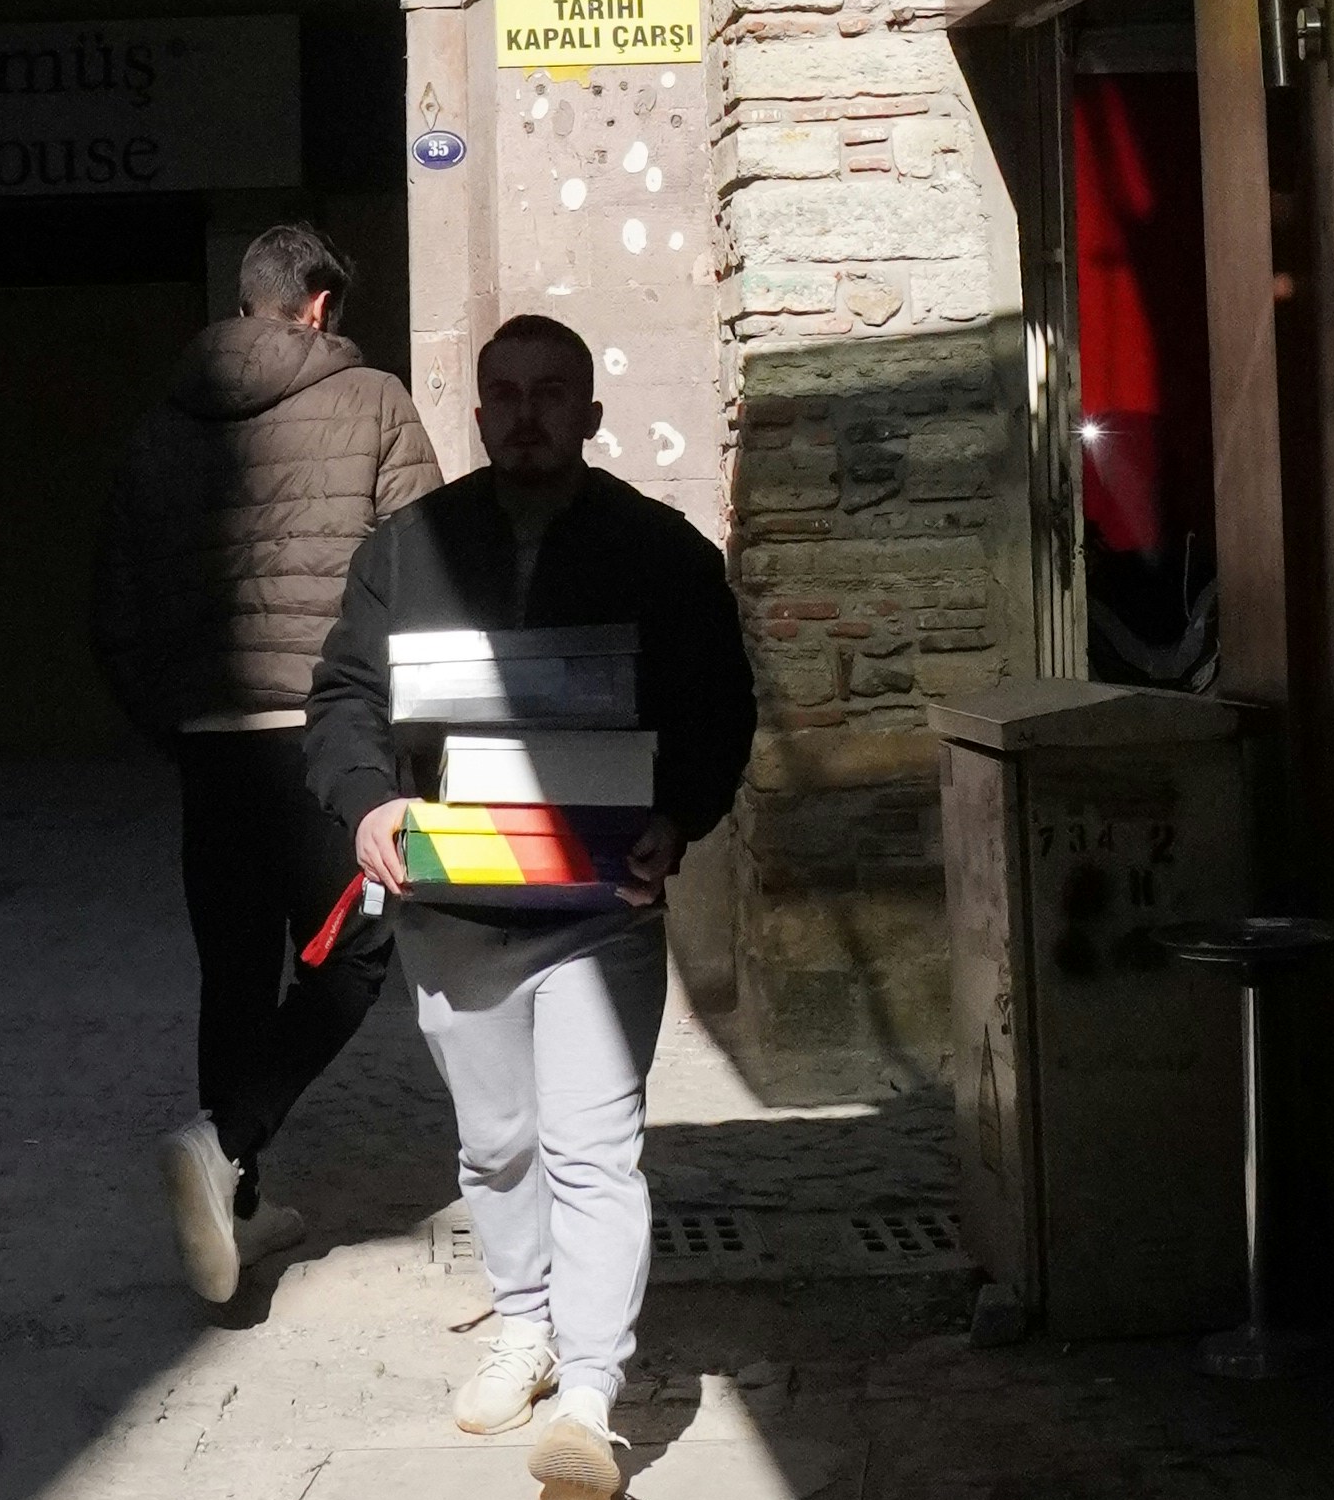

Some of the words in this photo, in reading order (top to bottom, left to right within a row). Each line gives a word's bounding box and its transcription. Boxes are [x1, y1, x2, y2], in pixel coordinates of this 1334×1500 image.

[506, 26, 602, 52] KAPALI
[611, 23, 694, 55] ÇARŞI
[428, 139, 450, 158] 35
